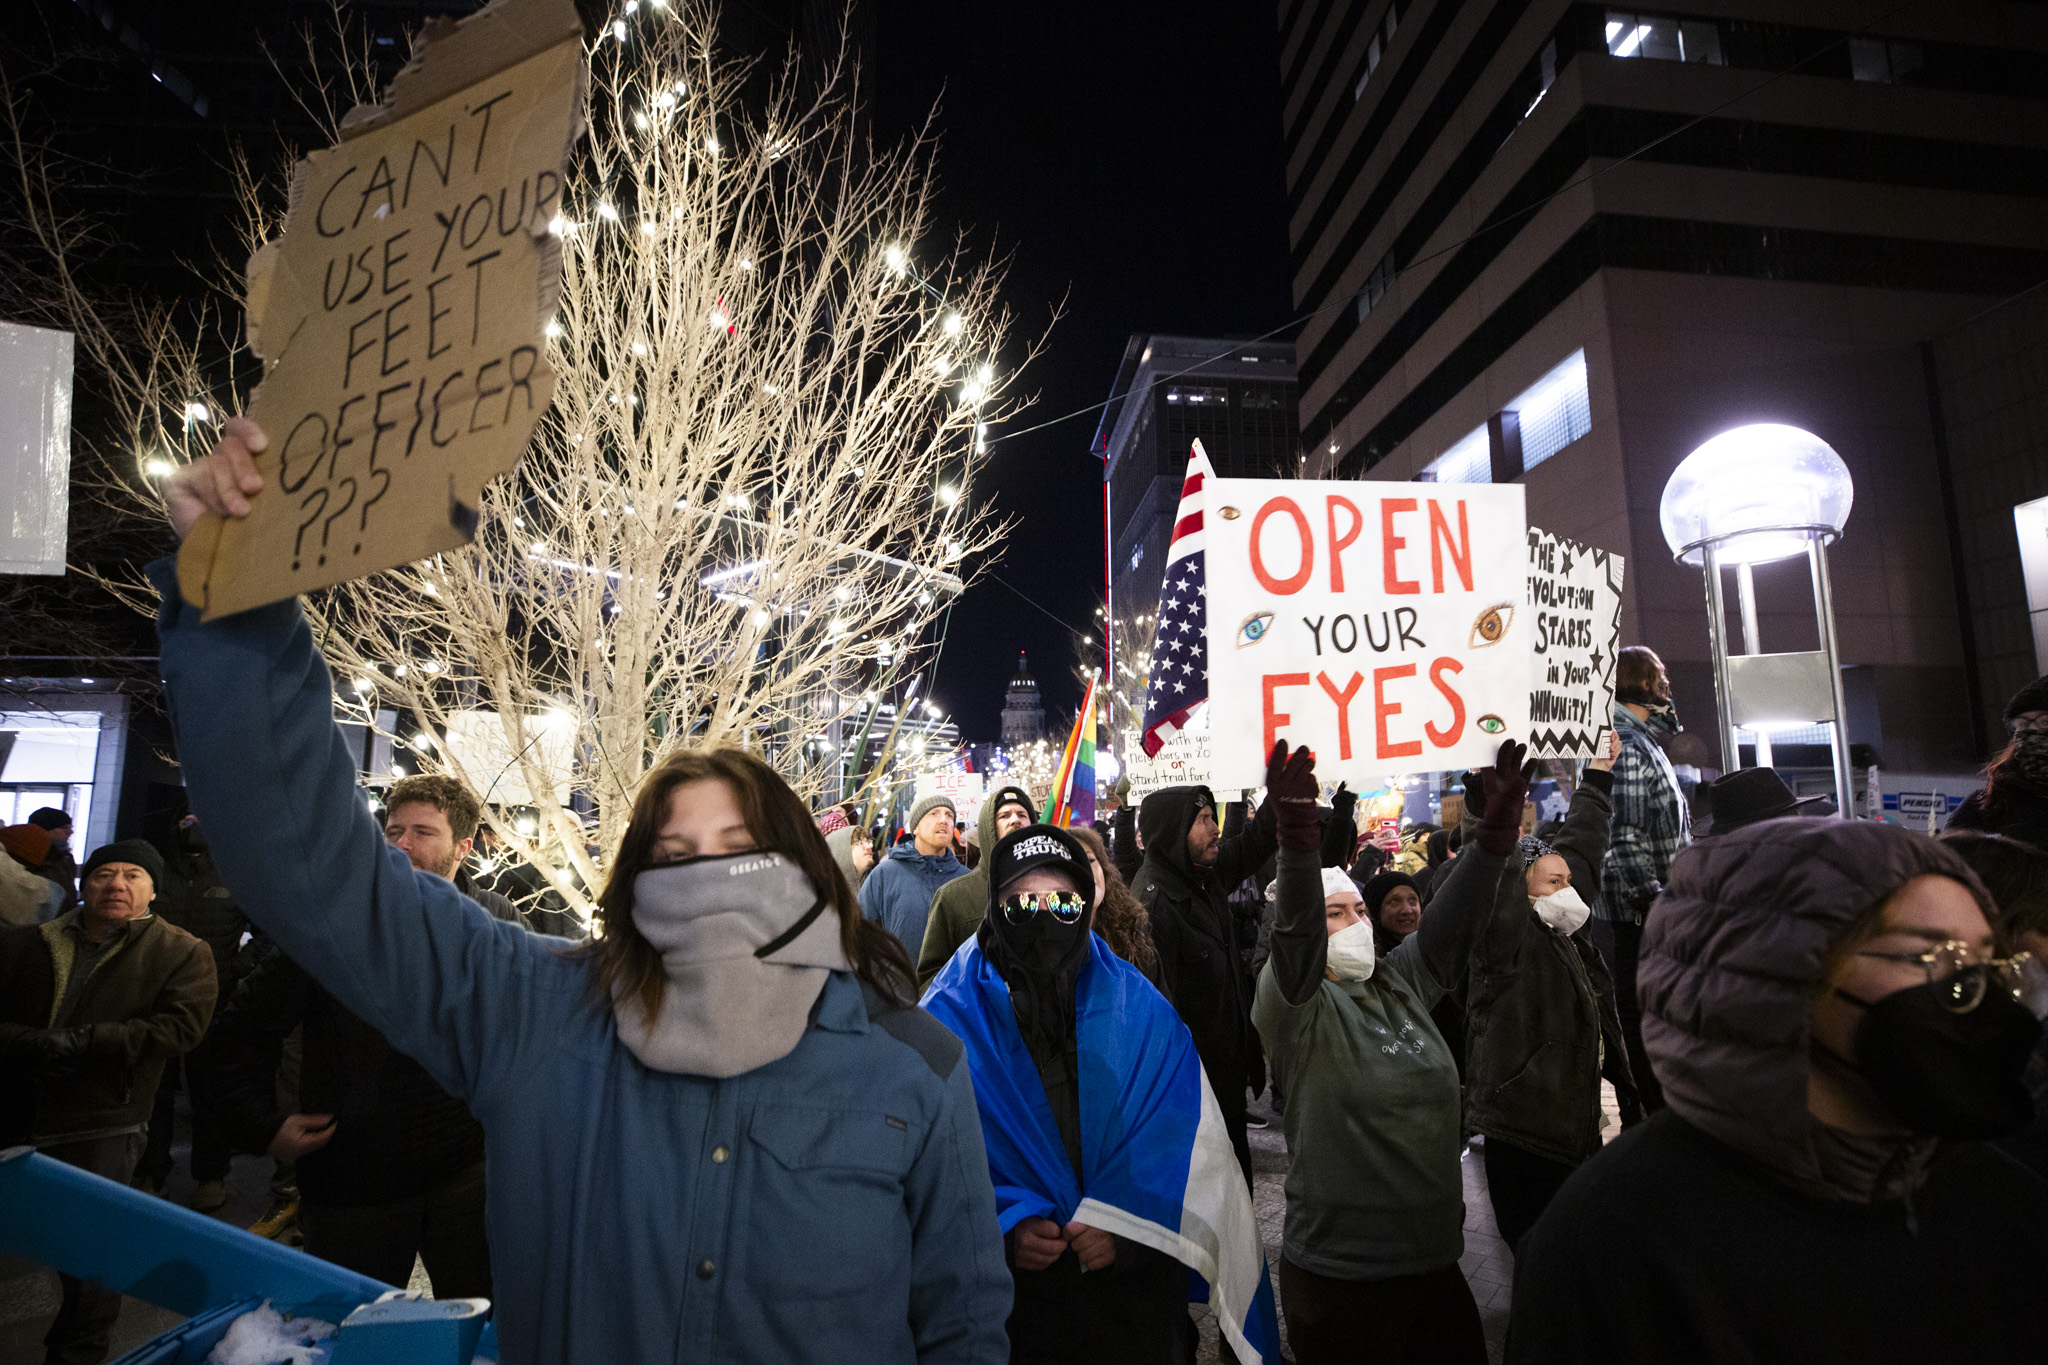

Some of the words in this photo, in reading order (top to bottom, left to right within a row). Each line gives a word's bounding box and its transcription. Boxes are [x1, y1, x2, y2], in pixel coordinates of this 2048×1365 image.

[323, 229, 412, 311] USE
[432, 170, 560, 272] YOUR
[344, 249, 501, 390] FEET
[279, 345, 539, 494] OFFICER
[291, 469, 391, 571] ???
[1249, 495, 1474, 596] OPEN
[1527, 531, 1555, 574] THE
[1303, 607, 1426, 656] YOUR
[1534, 612, 1591, 655] STARTS
[1563, 659, 1590, 688] YOUR
[1262, 656, 1466, 768] EYES
[1167, 731, 1190, 746] with
[935, 775, 967, 789] ICE
[1130, 769, 1159, 786] Stand
[1161, 768, 1187, 783] trial
[1189, 767, 1204, 782] for
[1171, 760, 1185, 770] or
[1013, 844, 1072, 861] TRUMP
